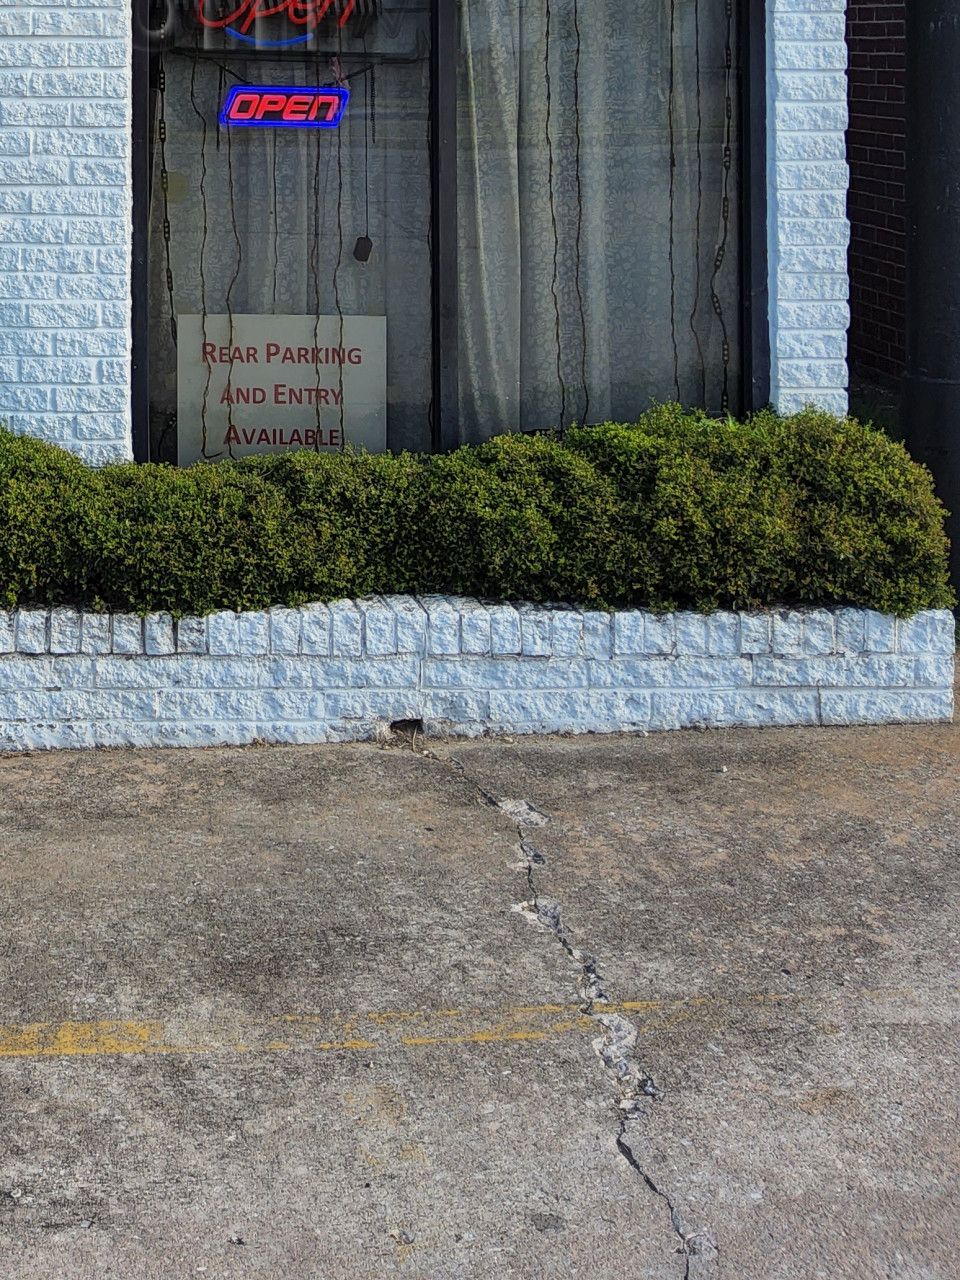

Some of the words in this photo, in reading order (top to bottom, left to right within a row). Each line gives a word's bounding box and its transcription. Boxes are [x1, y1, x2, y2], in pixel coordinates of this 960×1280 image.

[229, 93, 340, 121] OPEN
[202, 342, 259, 364] REAR
[266, 342, 362, 365] PARKING
[220, 384, 267, 405] AND
[274, 384, 344, 405] ENTRY
[223, 424, 340, 447] AVAILABLE
